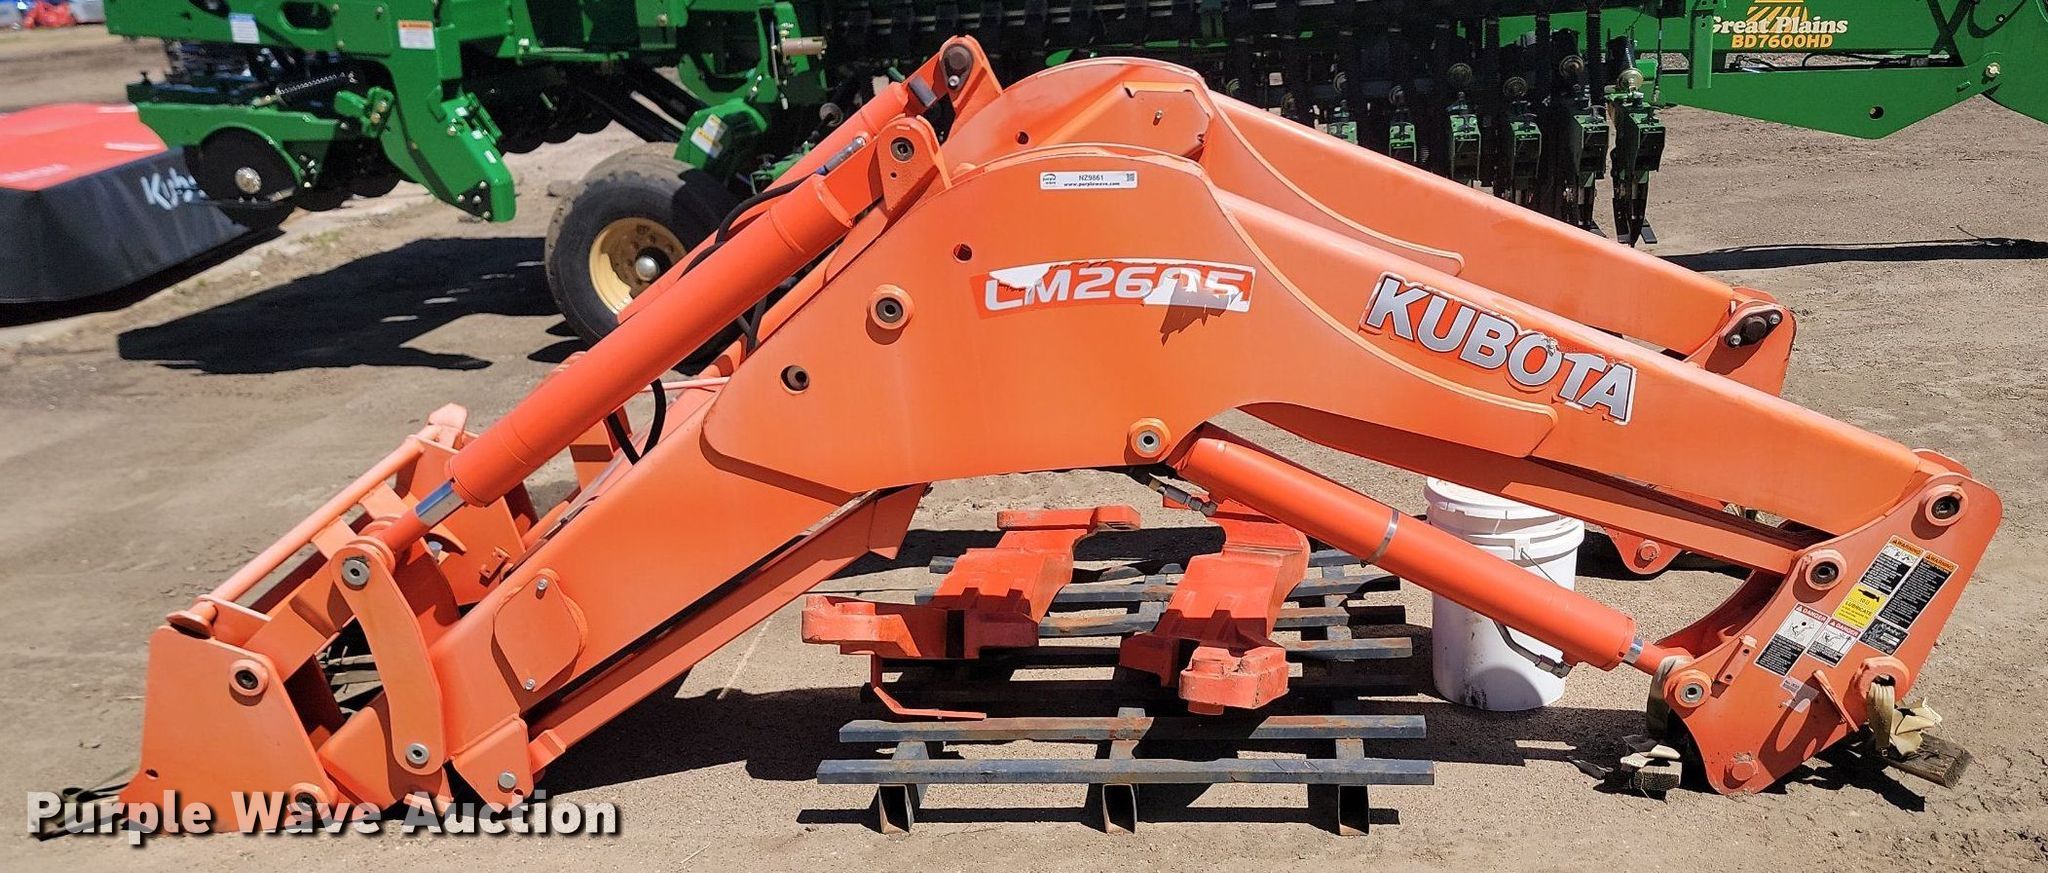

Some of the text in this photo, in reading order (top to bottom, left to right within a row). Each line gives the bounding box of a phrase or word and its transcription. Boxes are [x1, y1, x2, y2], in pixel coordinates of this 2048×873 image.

[1713, 16, 1849, 34] Great Plains
[1731, 34, 1833, 49] BD7600HD
[1365, 275, 1634, 422] KUBOTA
[1802, 607, 1828, 623] DANGER
[1835, 621, 1860, 637] DANGER
